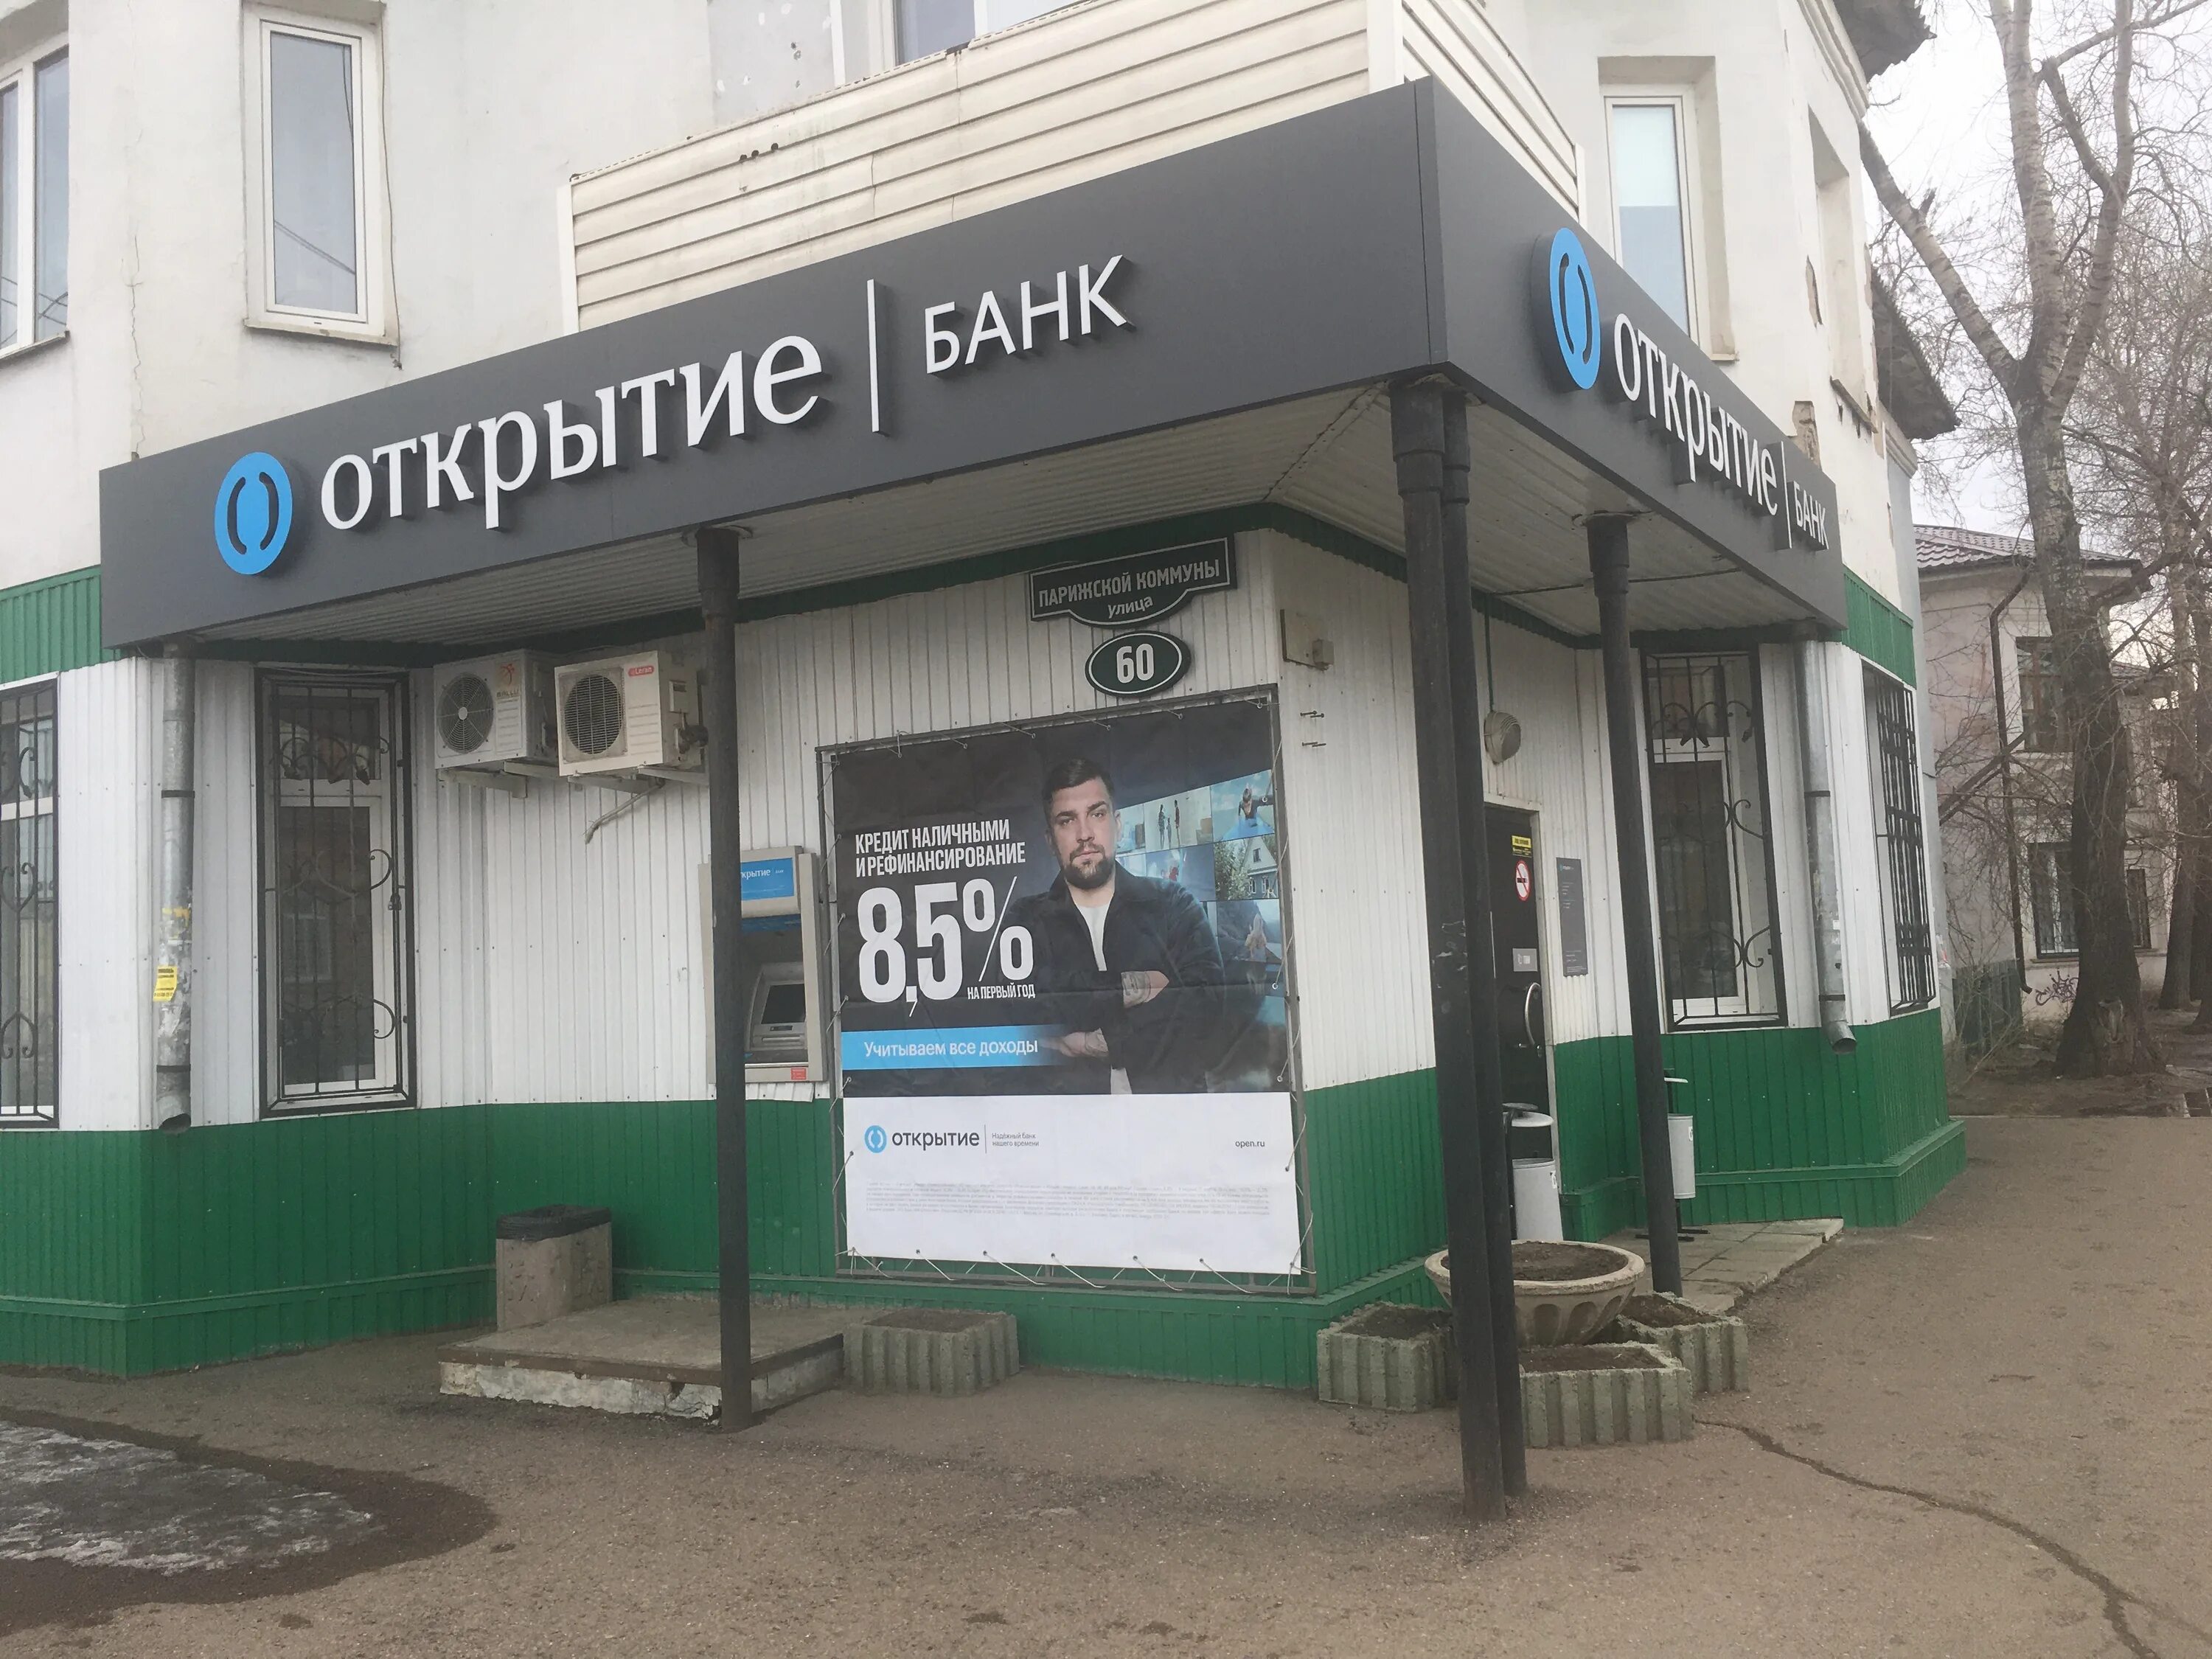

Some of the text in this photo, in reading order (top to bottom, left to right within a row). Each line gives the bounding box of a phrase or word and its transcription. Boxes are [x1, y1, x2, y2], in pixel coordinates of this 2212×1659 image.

[321, 254, 1127, 530] открытие БАНК
[1614, 313, 1829, 550] открытие БАНК
[1038, 559, 1220, 608] ПАРИЖСКОЙ КОММУНЫ
[1107, 596, 1153, 619] улица
[1116, 643, 1155, 684] 60
[855, 818, 1010, 855] КРЕДИТ НАЛИЧНЫМИ
[740, 869, 771, 880] крытие
[856, 841, 1026, 877] И РЕФИНАНСИРОВАНИЕ
[857, 875, 1034, 1017] 8,5%
[967, 982, 1036, 1000] НА ПЕРВЫЙ ГОД
[864, 1040, 1038, 1057] Учитываем все доходы
[891, 1132, 980, 1151] открытие
[1235, 1141, 1265, 1149] open.ru
